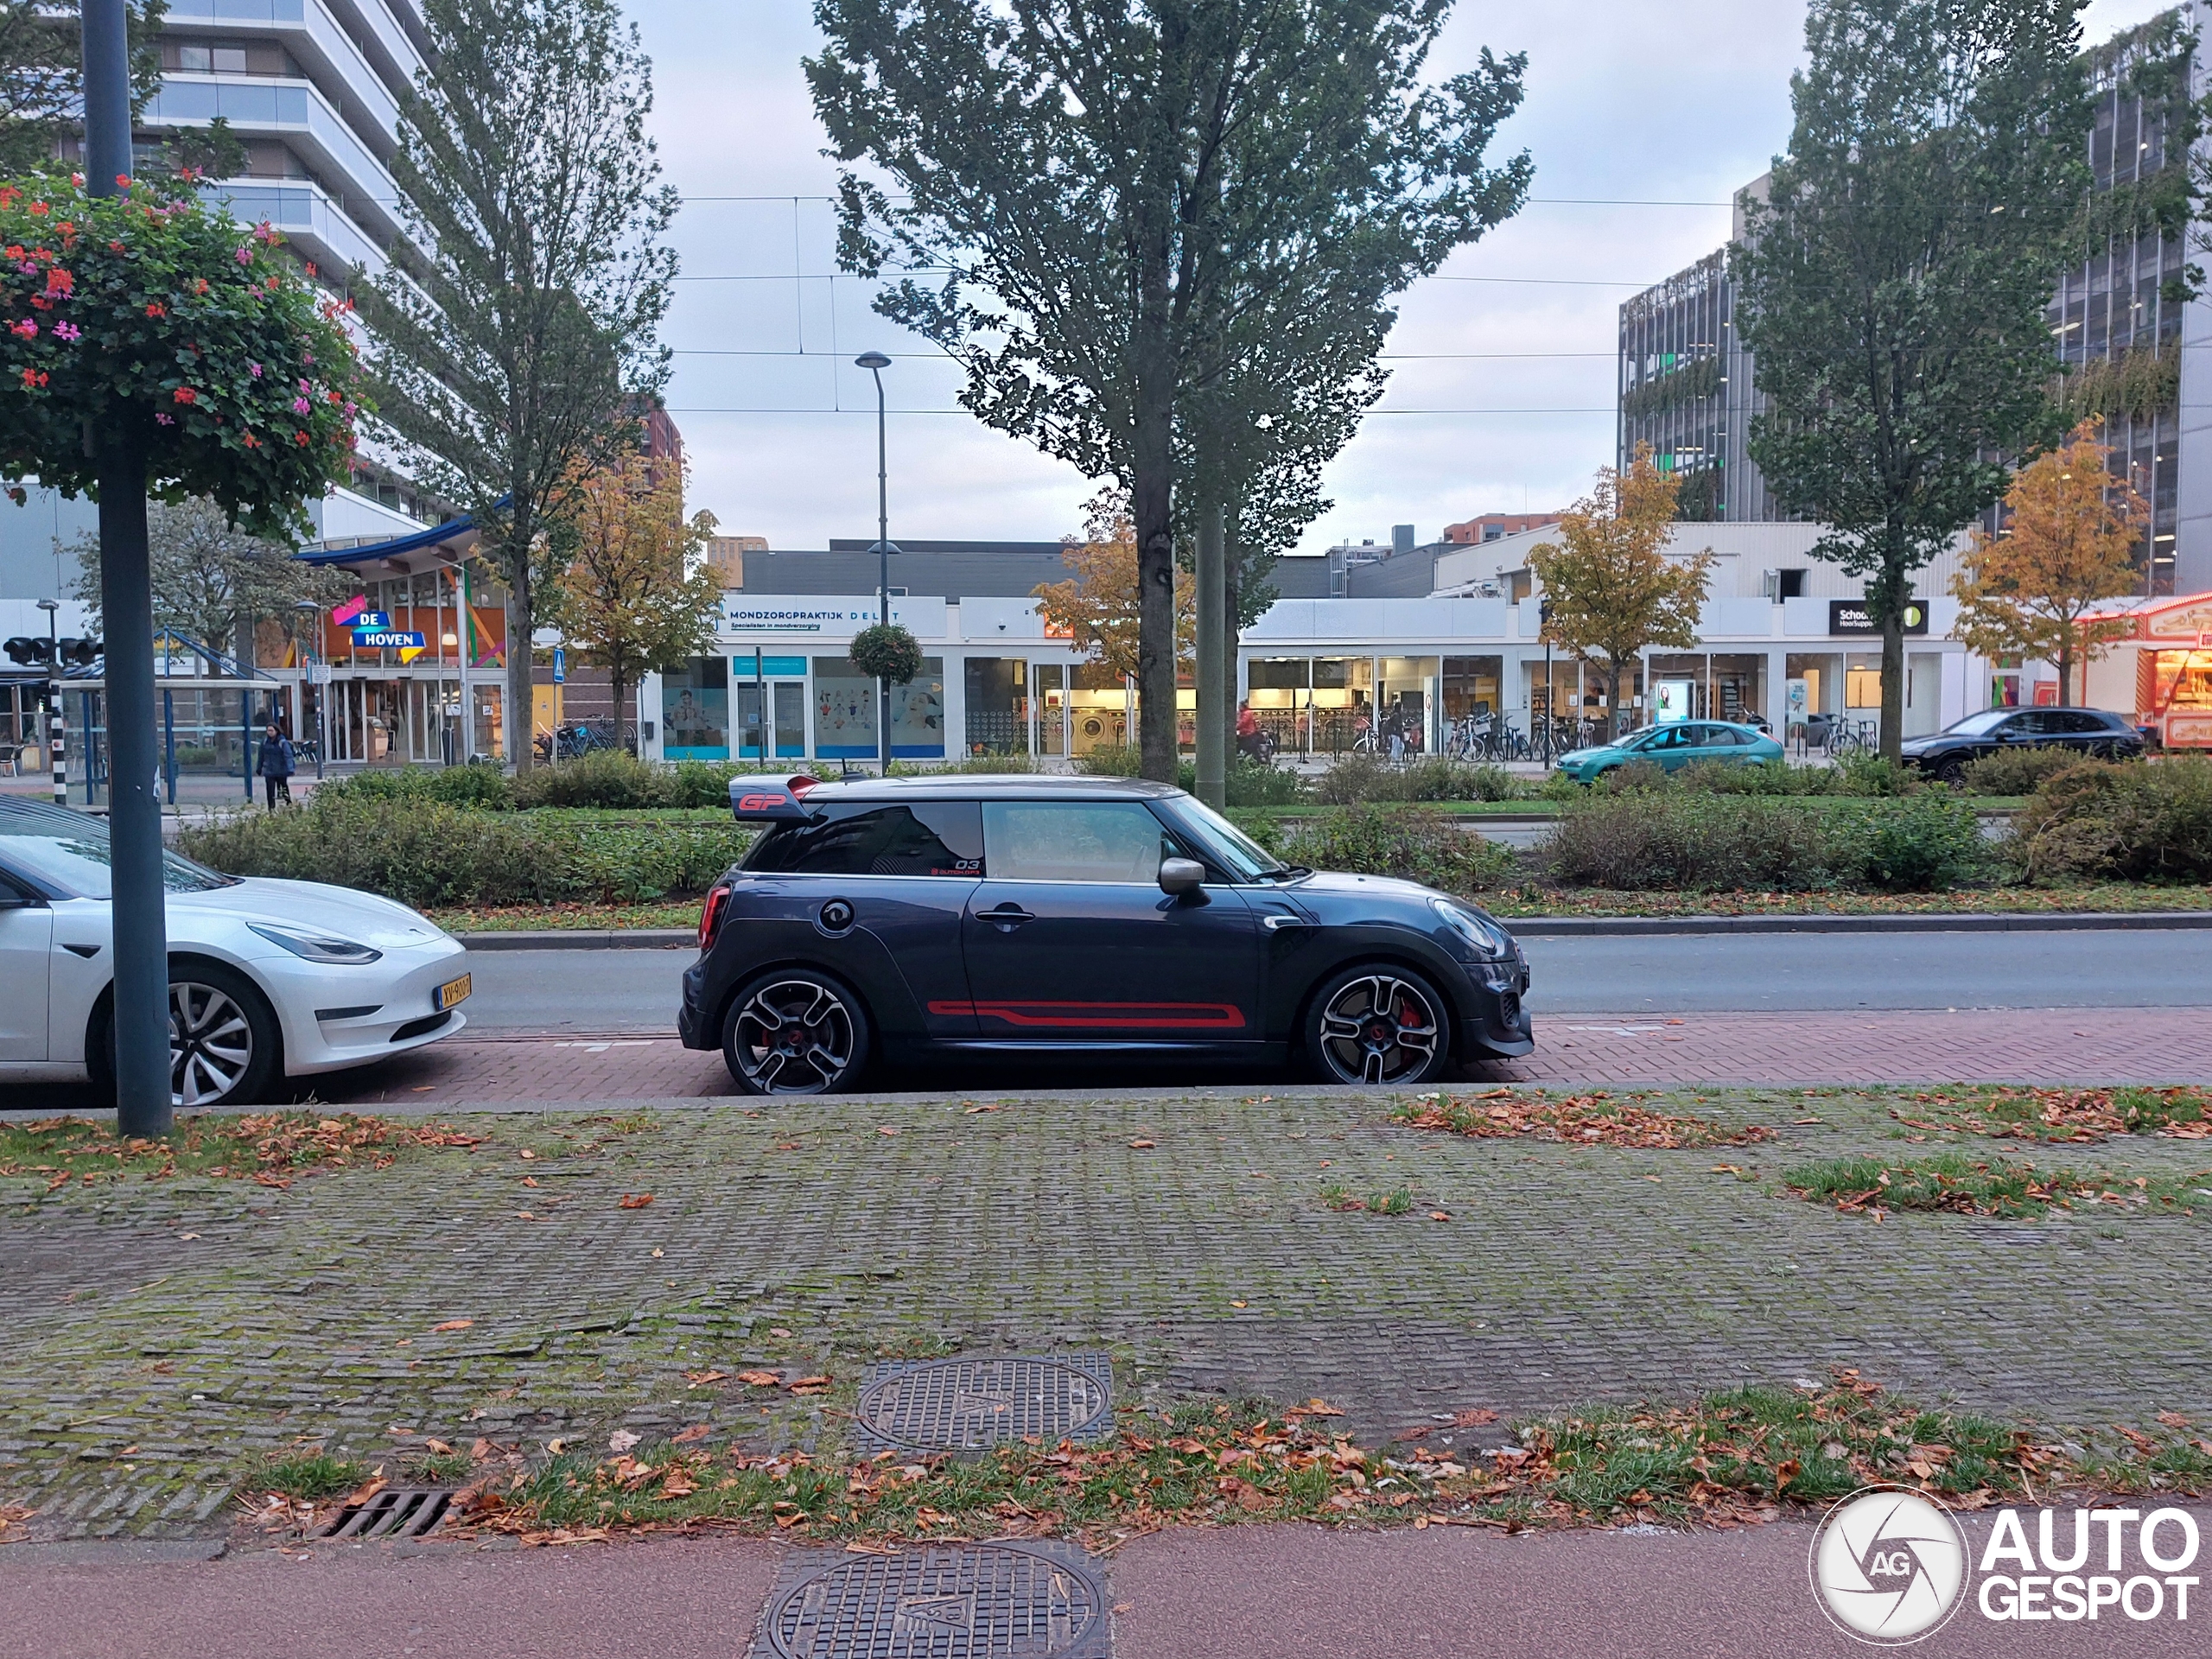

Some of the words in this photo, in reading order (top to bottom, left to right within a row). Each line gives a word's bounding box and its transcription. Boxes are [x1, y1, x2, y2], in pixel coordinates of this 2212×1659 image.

[359, 613, 378, 626] DE
[730, 611, 843, 620] MONDZORGPRAKTIJK
[850, 612, 899, 620] DELT
[365, 633, 414, 645] HOVEN
[738, 793, 787, 811] GP
[955, 860, 981, 869] 03
